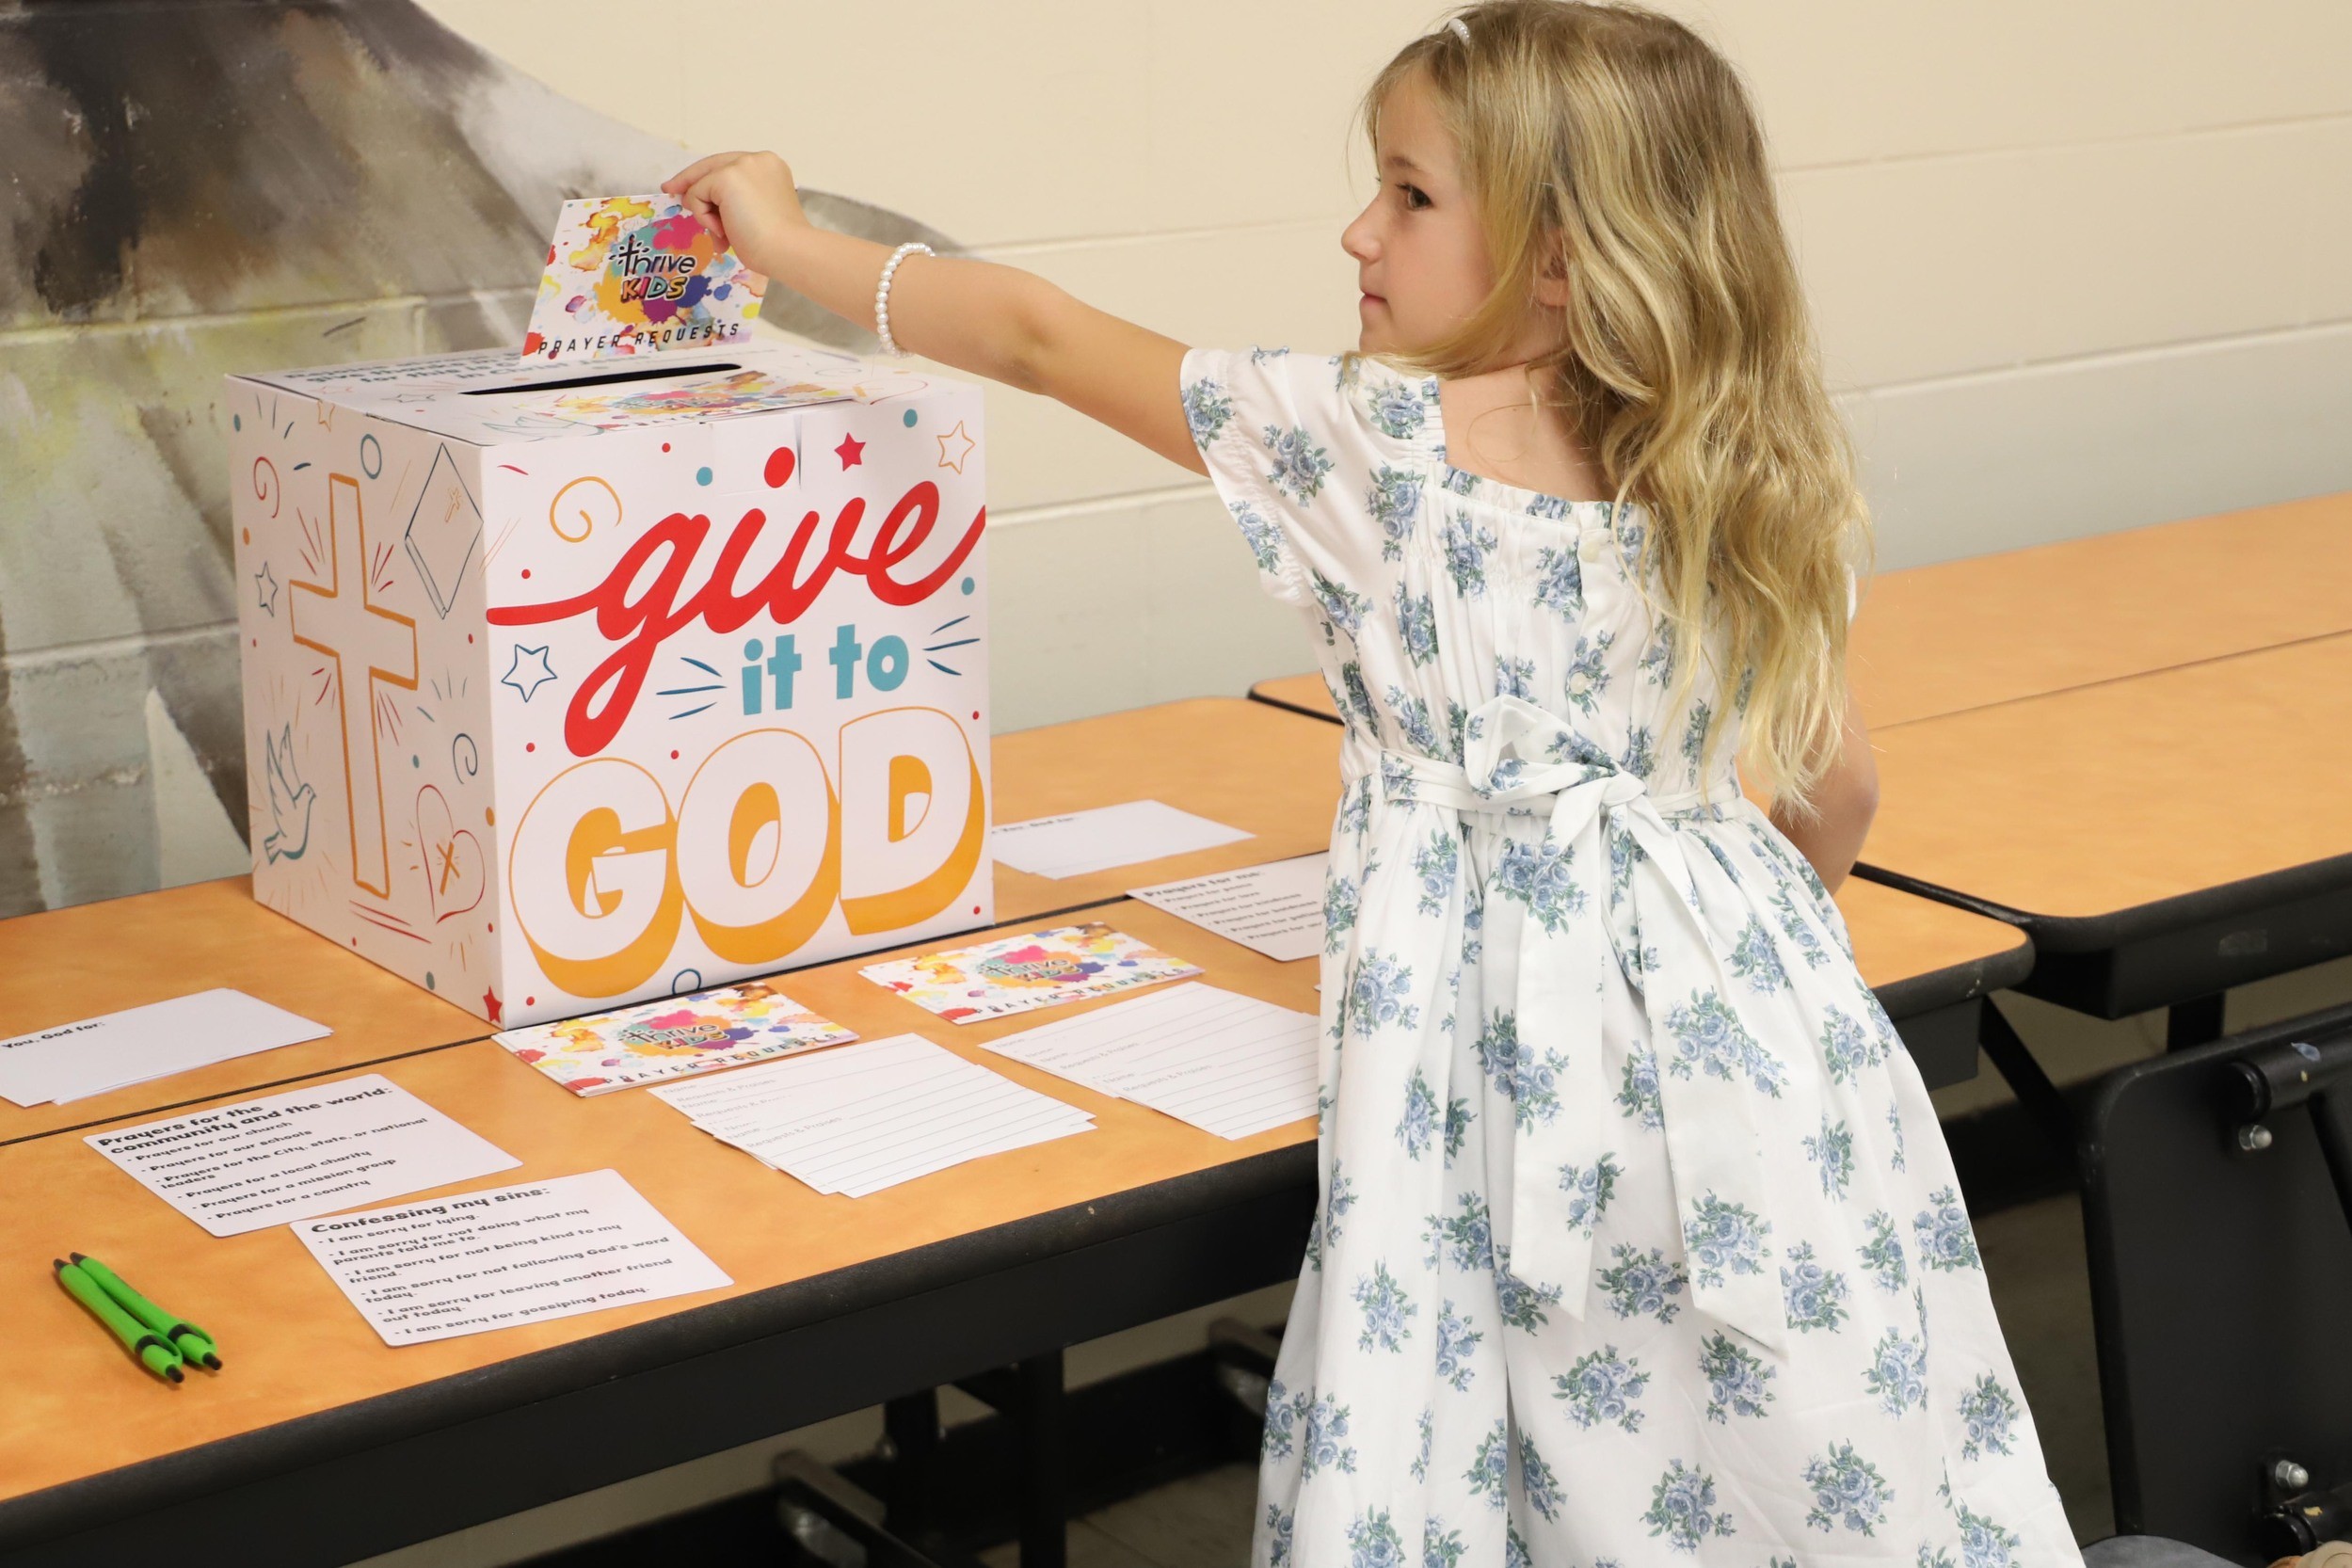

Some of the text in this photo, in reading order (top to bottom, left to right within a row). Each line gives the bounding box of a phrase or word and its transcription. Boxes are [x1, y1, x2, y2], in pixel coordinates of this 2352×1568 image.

[618, 234, 696, 277] thrive
[620, 276, 689, 303] KIDS
[537, 323, 740, 355] PRAYER REQUESTS
[487, 447, 985, 757] give
[742, 623, 909, 715] it to
[509, 706, 985, 999] GOD
[976, 968, 1185, 1015] PRAYER REQUESTS
[41, 1029, 73, 1039] God
[76, 1022, 105, 1031] for:
[627, 1024, 718, 1044] thrive
[604, 1032, 839, 1084] PRAYER REQUESTS
[98, 1106, 264, 1145] Prayers for the
[111, 1087, 393, 1154] community and the world:
[136, 1145, 191, 1160] Prayers
[195, 1139, 214, 1147] for
[245, 1122, 293, 1135] church
[745, 1130, 794, 1148] Requests
[804, 1116, 843, 1130] Praises
[150, 1156, 206, 1171] Prayers
[209, 1149, 228, 1158] for
[260, 1130, 312, 1145] schools
[164, 1166, 220, 1181] Prayers
[247, 1154, 271, 1162] the
[274, 1145, 309, 1156] City,
[311, 1135, 352, 1147] state,
[371, 1117, 428, 1133] national
[161, 1175, 216, 1189] leaders
[186, 1181, 242, 1197] Prayers
[282, 1163, 317, 1176] local
[320, 1150, 372, 1166] charity
[201, 1192, 258, 1208] Prayers
[261, 1186, 280, 1194] for
[298, 1169, 354, 1186] mission
[357, 1159, 396, 1172] group
[216, 1203, 273, 1218] Prayers
[276, 1196, 296, 1205] for
[313, 1179, 371, 1196] country
[312, 1188, 551, 1233] Confessing my sins:
[339, 1233, 362, 1241] am
[367, 1225, 408, 1237] sorry
[436, 1214, 480, 1225] lying.
[377, 1239, 419, 1250] sorry
[448, 1228, 473, 1237] not
[478, 1219, 520, 1232] doing
[523, 1212, 562, 1223] what
[393, 1257, 436, 1269] sorry
[465, 1246, 489, 1256] not
[494, 1239, 538, 1250] being
[540, 1231, 575, 1242] kind
[599, 1224, 622, 1232] my
[333, 1250, 393, 1265] parents
[397, 1243, 428, 1253] told
[382, 1285, 407, 1293] am
[410, 1277, 454, 1288] sorry
[482, 1266, 509, 1275] not
[513, 1251, 584, 1270] following
[587, 1244, 629, 1256] God's
[632, 1237, 669, 1247] word
[349, 1272, 402, 1284] friend.
[365, 1291, 417, 1304] today.
[398, 1304, 424, 1313] am
[428, 1297, 472, 1308] sorry
[473, 1291, 496, 1300] for
[500, 1280, 560, 1295] leaving
[563, 1268, 622, 1283] another
[627, 1258, 673, 1272] friend
[383, 1306, 466, 1322] out today.
[445, 1317, 489, 1328] sorry
[520, 1296, 597, 1316] gossiping
[599, 1286, 650, 1300] today.
